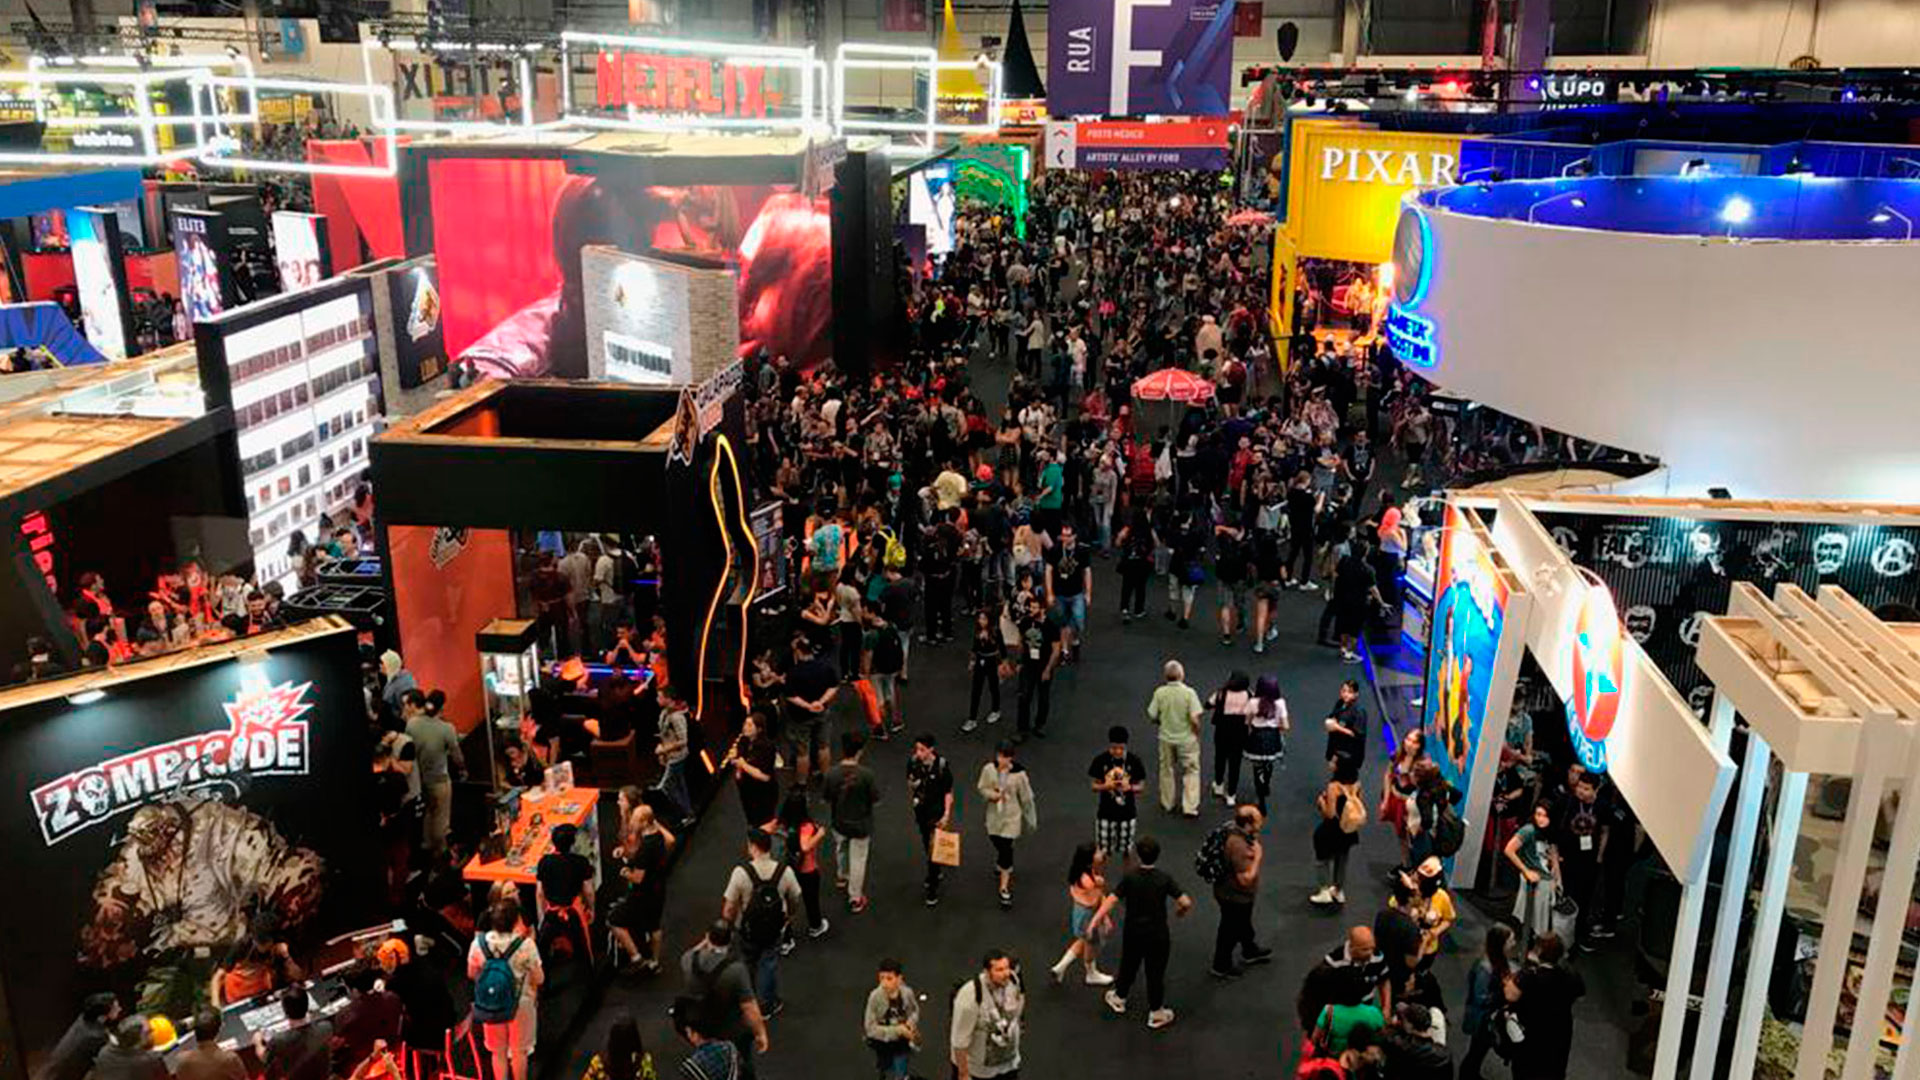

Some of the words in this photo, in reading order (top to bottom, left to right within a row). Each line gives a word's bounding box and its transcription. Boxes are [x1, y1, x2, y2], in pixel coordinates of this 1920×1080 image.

[1066, 26, 1092, 73] RUA
[597, 49, 768, 119] NETFLIX
[1321, 147, 1457, 187] PIXAR
[42, 722, 303, 834] ZOMBICIDE
